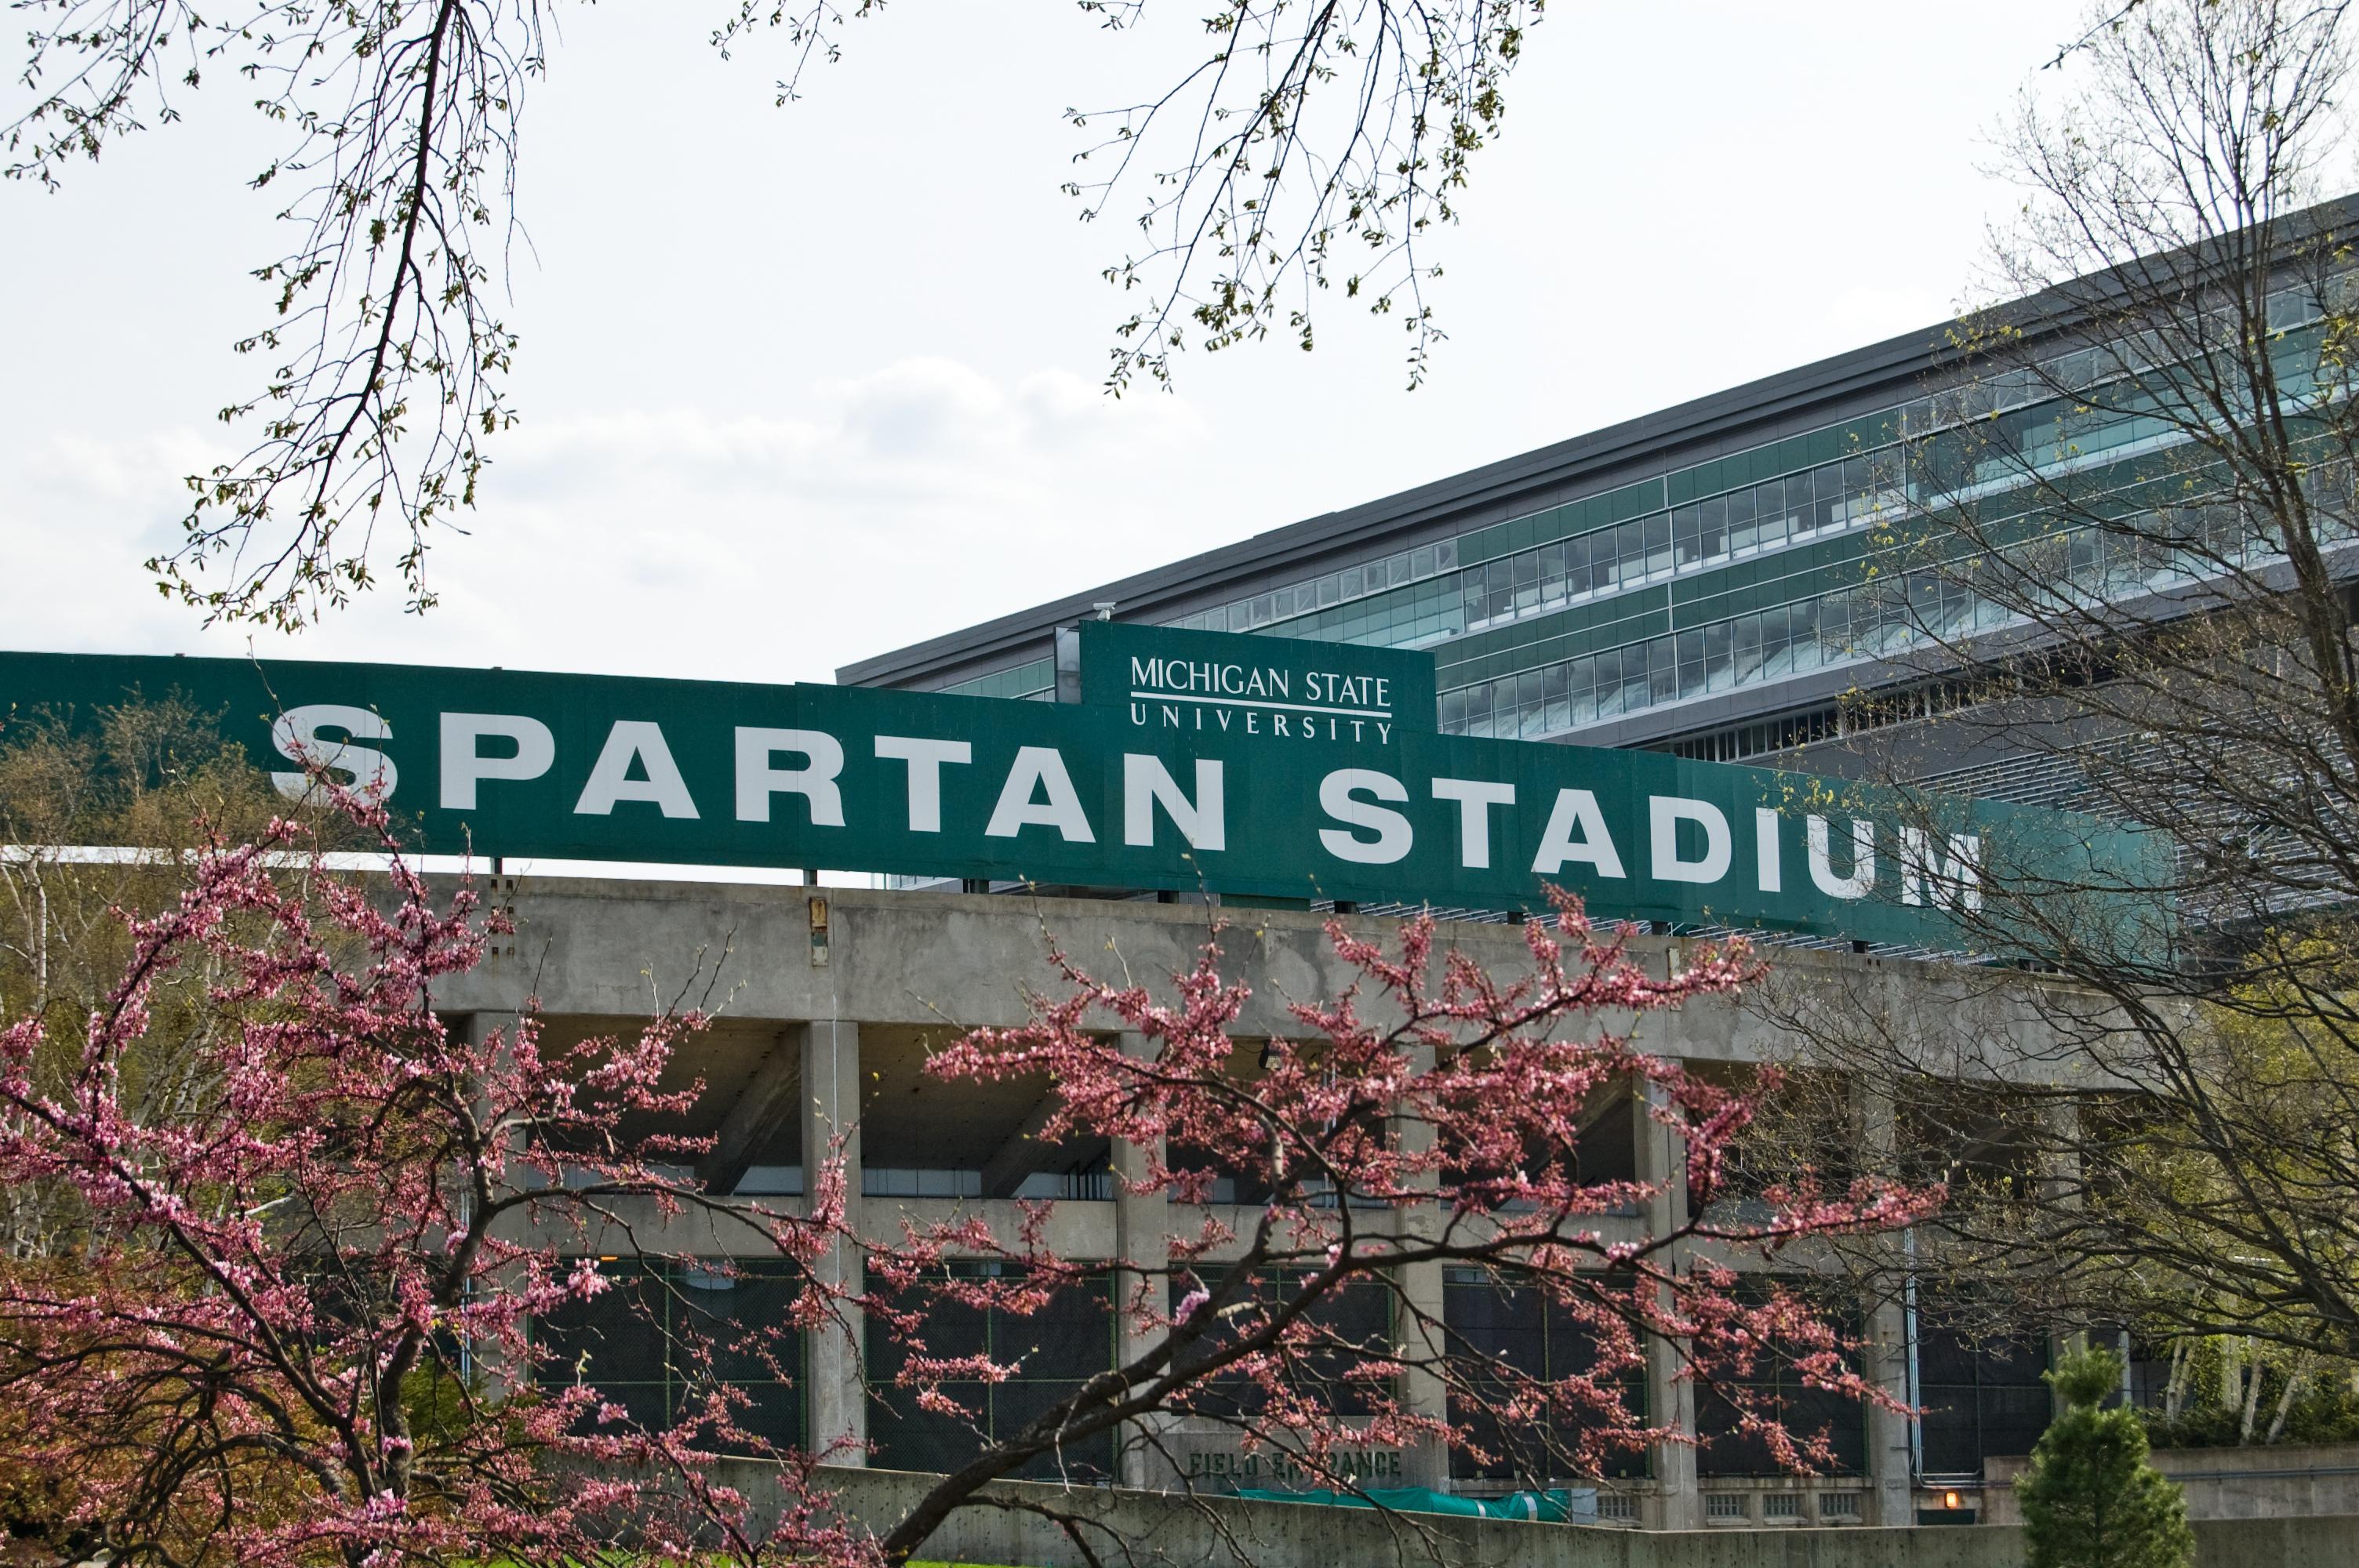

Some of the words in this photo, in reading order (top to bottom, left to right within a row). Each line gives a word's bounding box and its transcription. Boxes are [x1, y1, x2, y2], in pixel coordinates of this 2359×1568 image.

[1131, 656, 1289, 699] MICHIGAN
[1306, 672, 1391, 707] STATE
[1130, 702, 1391, 745] UNIVERSITY
[270, 704, 1226, 851] SPARTAN
[1318, 768, 1983, 915] STADIUM
[1190, 1453, 1258, 1479] FIELD
